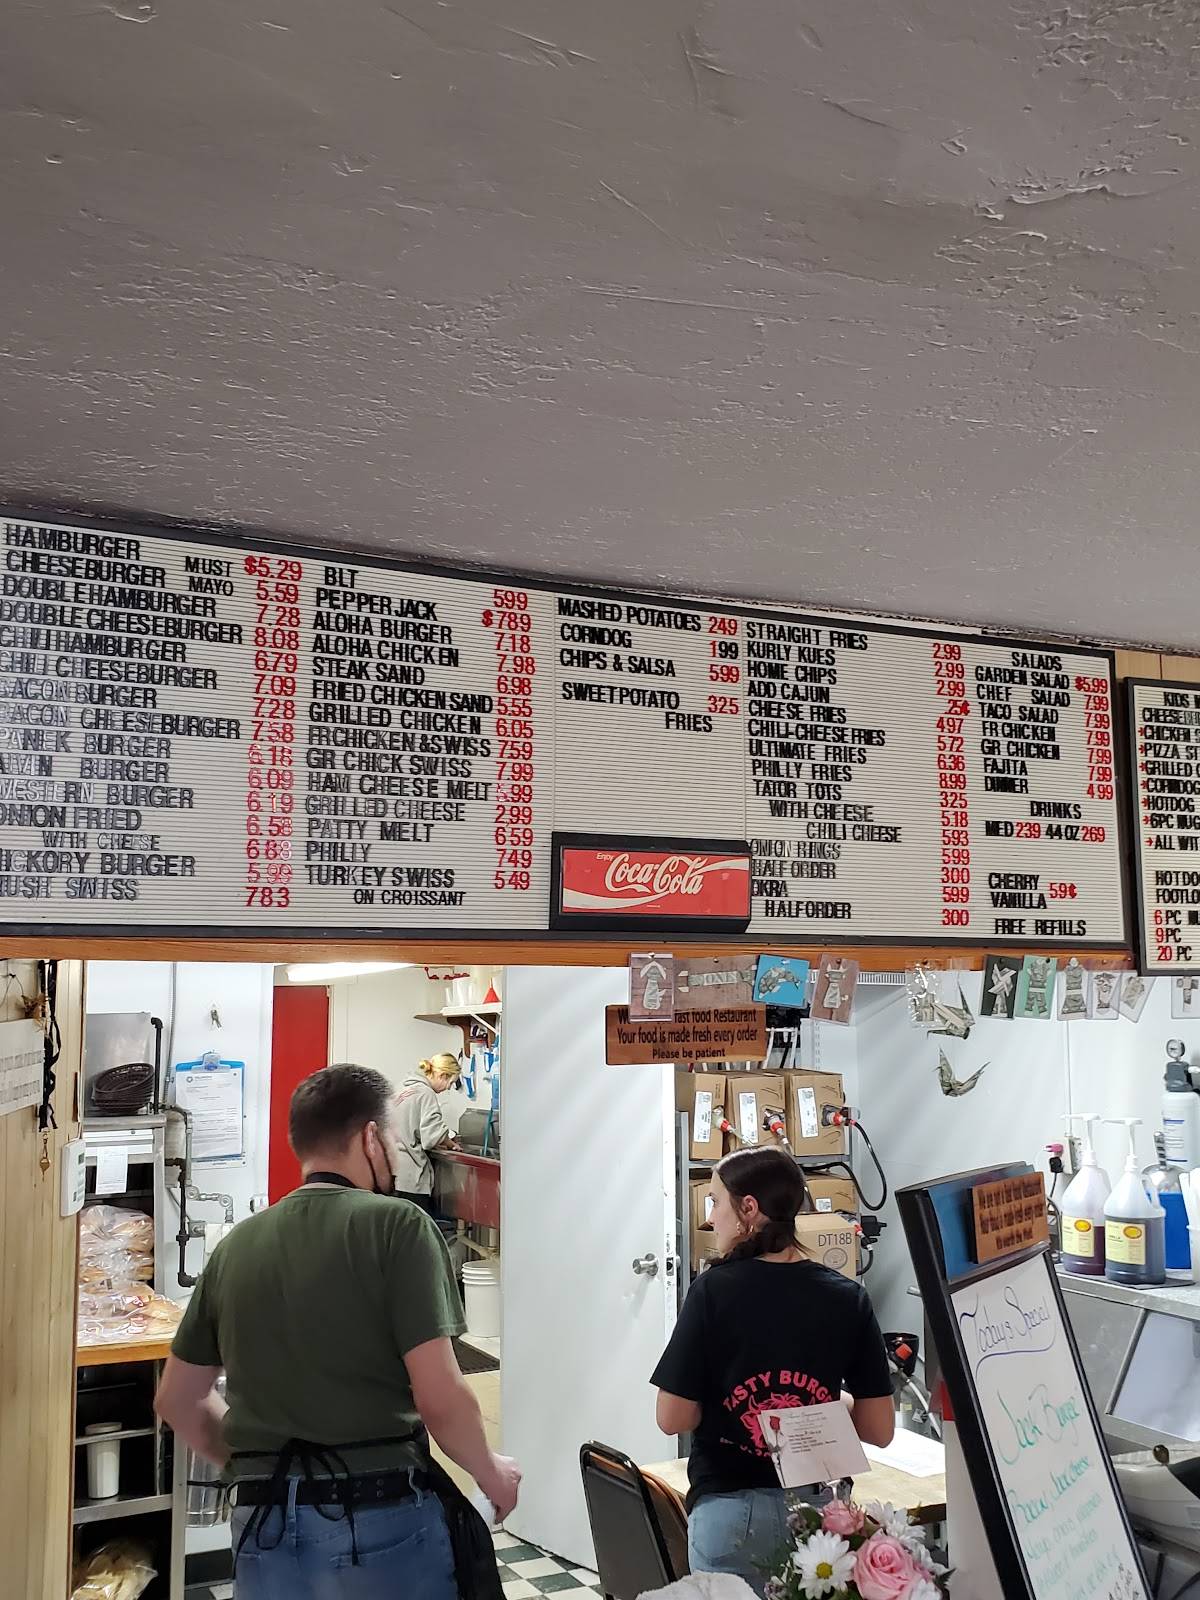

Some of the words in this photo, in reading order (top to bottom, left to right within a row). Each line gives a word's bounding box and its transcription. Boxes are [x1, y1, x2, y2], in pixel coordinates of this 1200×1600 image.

[5, 524, 140, 561] HAMBURGER
[6, 551, 166, 588] CHEESEBURGER
[185, 556, 233, 577] MUST
[244, 555, 302, 581] $5.29
[324, 566, 359, 588] BLT
[4, 574, 86, 602] DOUBLE
[90, 583, 216, 618] HAMBURGER
[257, 604, 300, 627] 7.28
[188, 576, 234, 596] MAYO
[257, 580, 299, 604] 5.59
[316, 588, 391, 615] PEPPER
[395, 599, 438, 621] JACK
[558, 598, 622, 622] MASHED
[627, 606, 701, 631] POTATOES
[708, 616, 737, 635] 249
[87, 609, 243, 645] CHEESEBURGER
[254, 627, 300, 650] 8.08
[313, 612, 373, 635] ALOHA
[381, 619, 452, 644] BURGER
[495, 632, 531, 653] 7.18
[561, 623, 632, 648] CORNDOG
[747, 622, 821, 645] STRAIGHT
[830, 631, 868, 650] FRIES
[56, 633, 186, 662] HAMBURGER
[255, 650, 297, 673] 6.79
[313, 635, 373, 658] ALOHA
[377, 641, 459, 667] CHICKEN
[497, 654, 535, 675] 7.98
[709, 641, 739, 659] 199
[748, 641, 792, 662] KURLY
[798, 646, 835, 665] KUES
[1012, 652, 1062, 671] SALADS
[56, 656, 217, 689] CHEESEBURGER
[254, 674, 296, 696] 7.09
[313, 657, 370, 680] STEAK
[376, 663, 425, 685] SAND
[497, 675, 531, 696] 6.98
[560, 649, 607, 669] CHIPS
[613, 654, 623, 671] &
[628, 656, 675, 677] SALSA
[709, 664, 740, 683] 599
[748, 661, 788, 680] HOME
[795, 666, 837, 685] CHIPS
[975, 666, 1027, 685] GARDEN
[1031, 672, 1069, 689] SALAD
[75, 685, 157, 709] BURGER
[253, 697, 295, 720] 7.28
[313, 680, 365, 703] FRIED
[371, 685, 446, 709] CHICKEN
[450, 693, 493, 714] SAND
[497, 697, 532, 717] 5.55
[562, 682, 618, 703] SWEET
[620, 689, 680, 710] POTATO
[708, 696, 739, 714] 325
[748, 680, 776, 698] ADD
[781, 683, 830, 703] CAJUN
[977, 684, 1012, 701] CHEF
[1031, 690, 1070, 707] SALAD
[1164, 692, 1189, 708] KIDS
[309, 702, 391, 727] GRILLED
[401, 710, 481, 734] CHICKEN
[496, 718, 533, 738] 6.05
[665, 712, 712, 732] FRIES
[749, 700, 805, 720] CHEESE
[810, 707, 846, 724] FRIES
[979, 702, 1011, 719] TACO
[1019, 706, 1058, 724] SALAD
[81, 707, 240, 739] CHEESEBURGER
[251, 721, 295, 743] 7.58
[983, 721, 998, 736] FR
[1002, 723, 1056, 742] CHICKEN
[851, 728, 885, 746] FRIES
[84, 734, 171, 759] BURGER
[249, 743, 294, 767] 6.18
[749, 739, 816, 761] ULTIMATE
[825, 745, 867, 764] FRIES
[981, 739, 1001, 755] GR
[1007, 741, 1060, 760] CHICKEN
[80, 758, 170, 783] BURGER
[248, 768, 294, 790] 6.09
[306, 748, 335, 769] GR
[344, 751, 401, 772] CHICK
[410, 755, 472, 778] SWISS
[496, 762, 533, 782] 7.99
[752, 760, 802, 779] PHILLY
[812, 764, 852, 781] FRIES
[984, 758, 1028, 776] FAJITA
[107, 785, 194, 809] BURGER
[308, 772, 350, 793] HAM
[359, 774, 439, 798] CHEESE
[447, 780, 492, 801] MELT
[752, 779, 797, 798] TATOR
[806, 783, 842, 800] TOTS
[940, 791, 968, 808] 325
[73, 807, 142, 830] FRIED
[305, 795, 389, 817] GRILLED
[395, 800, 466, 821] CHEESE
[769, 800, 809, 818] WITH
[814, 802, 874, 822] CHEESE
[1030, 801, 1082, 819] DRINKS
[43, 831, 87, 848] WITH
[98, 833, 161, 851] CHEESE
[308, 818, 367, 840] PATTY
[380, 822, 434, 842] MELT
[853, 825, 902, 842] CHEESE
[942, 830, 969, 846] 593
[1015, 822, 1041, 838] 239
[1081, 826, 1105, 842] 269
[307, 841, 371, 862] PHILLY
[1155, 835, 1175, 850] ALL
[100, 855, 196, 876] BURGER
[942, 849, 970, 865] 599
[305, 865, 387, 886] TURKEY
[392, 867, 455, 888] SWISS
[605, 853, 708, 894] Coca-Cola
[941, 867, 970, 884] 300
[989, 873, 1040, 890] CHERRY
[65, 877, 140, 901] SWISS
[246, 887, 290, 907] 783
[354, 889, 374, 904] ON
[382, 890, 466, 905] CROISSANT
[942, 886, 970, 903] 599
[991, 892, 1047, 909] VANILLA
[765, 899, 805, 917] HALF
[806, 901, 851, 919] ORDER
[942, 909, 970, 926] 300
[1154, 910, 1162, 925] 6
[1165, 910, 1182, 925] PC
[994, 919, 1026, 934] FREE
[1035, 919, 1086, 936] REFILLS
[1155, 928, 1164, 942] 9
[1166, 928, 1182, 942] PC
[1157, 946, 1172, 960] 20
[1176, 946, 1192, 960] PC
[714, 1009, 757, 1023] Restaurant
[617, 1027, 636, 1044] Your
[639, 1027, 657, 1043] food
[659, 1025, 666, 1043] is
[668, 1027, 690, 1043] made
[693, 1026, 711, 1042] fresh
[714, 1030, 734, 1045] every
[737, 1029, 757, 1041] order
[653, 1049, 679, 1059] Please
[682, 1048, 692, 1057] be
[695, 1048, 725, 1059] patient
[818, 1233, 852, 1246] DT18B
[723, 1371, 772, 1411] TASTY
